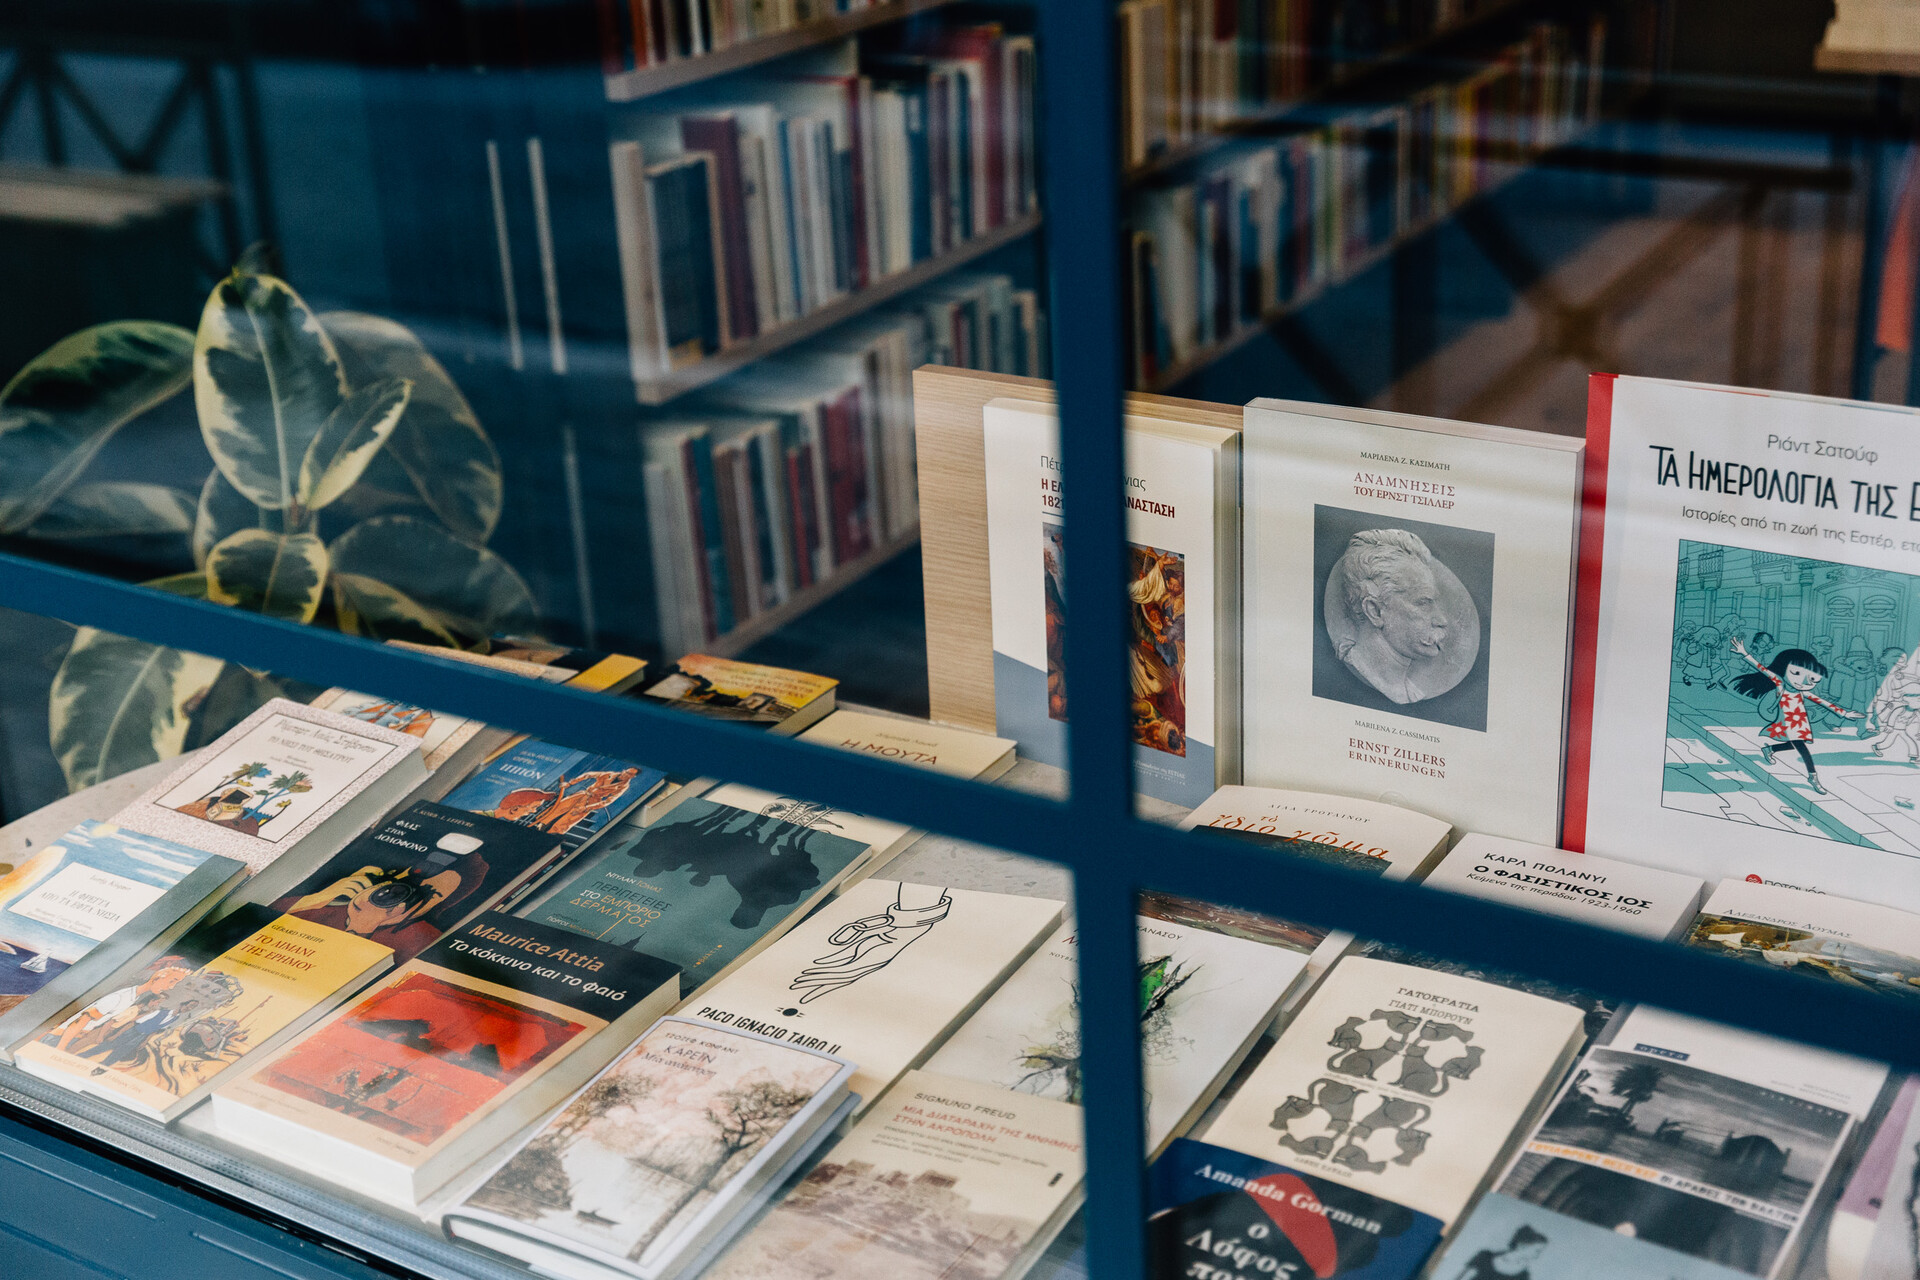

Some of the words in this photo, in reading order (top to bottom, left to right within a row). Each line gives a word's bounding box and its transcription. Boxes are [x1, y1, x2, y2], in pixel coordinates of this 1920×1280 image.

[1360, 451, 1400, 463] ΜΑΡΙΛΕΝΑ
[1409, 459, 1450, 471] ΚΑΣΙΜΑΤΗ
[1768, 434, 1810, 454] Ριάντ
[1815, 440, 1879, 466] Σατούφ
[1354, 472, 1456, 497] ΑΝΑΜΝΗΣΕΙΣ
[1649, 444, 1680, 487] ΤΑ
[1688, 450, 1839, 510] ΗΜΕΡΟΛΟΓΙΑ
[1851, 480, 1898, 519] ΤΗΣ
[1353, 486, 1375, 496] ΤΟΥ
[1376, 489, 1409, 503] ΕΡΝΣΤ
[1411, 494, 1455, 510] ΤΣΙΛΛΕΡ
[1682, 505, 1737, 528] Ιστορίες
[1740, 516, 1768, 530] από
[1772, 520, 1787, 532] τη
[1791, 522, 1818, 537] ζωή
[1822, 528, 1846, 543] της
[1354, 720, 1391, 733] MARILENA
[1399, 730, 1440, 743] CASSIMATIS
[840, 739, 861, 749] Η
[862, 743, 937, 765] ΜΟΥΤΑ
[1349, 738, 1390, 755] ERNST
[1393, 747, 1446, 767] ZILLERS
[1349, 751, 1446, 779] ERINNERUNGEN
[374, 833, 429, 853] ΔΟΛΟΦΟΝΟ
[384, 827, 407, 837] ΣΤΟΝ
[605, 871, 637, 884] ΝΤΥΛΑΝ
[1484, 853, 1526, 867] ΚΑΡΛ
[1532, 862, 1608, 884] ΠΟΛΑΝΥΙ
[591, 880, 673, 912] ΠΕΡΙΠΕΤΕΙΕΣ
[1466, 872, 1507, 887] Κείμενα
[1510, 883, 1528, 891] της
[1529, 887, 1577, 902] περιόδου
[1581, 897, 1642, 916] 1923-1960
[1474, 865, 1490, 873] Ο
[1493, 868, 1613, 901] ΦΑΣΙΣΤΙΚΟΣ
[1616, 895, 1654, 910] ΙΟΣ
[570, 897, 651, 930] ΔΕΡΜΑΤΟΣ
[579, 889, 601, 900] ΣΤΟ
[600, 894, 661, 919] ΕΜΠΟΡΙΟ
[1723, 909, 1799, 926] ΑΛΕΞΑΝΔΡΟΣ
[1802, 923, 1852, 938] ΔΟΥΜΑΣ
[240, 943, 267, 956] ΤΗΣ
[264, 951, 317, 971] ΕΡΗΜΟΥ
[255, 933, 273, 945] ΤΟ
[271, 940, 316, 957] ΛΙΜΑΝΙ
[468, 923, 551, 956] Maurice
[548, 948, 605, 973] Attia
[449, 939, 470, 952] Το
[468, 947, 532, 971] κόκκινο
[531, 966, 562, 981] και
[561, 974, 583, 988] το
[582, 981, 628, 1001] φαιό
[1388, 1000, 1419, 1012] ΓΙΑΤΙ
[1420, 1006, 1473, 1025] ΜΠΟΡΟΥΝ
[1397, 987, 1480, 1013] ΓΑΤΟΚΡΑΤΙΑ
[697, 1006, 735, 1023] PACO
[732, 1016, 788, 1040] IGNACIO
[913, 1092, 972, 1111] SIGMUND
[973, 1105, 1016, 1120] FREUD
[892, 1114, 927, 1128] ΣΤΗΝ
[927, 1123, 998, 1143] ΑΚΡΟΠΟΛΗ
[901, 1105, 924, 1117] ΜΙΑ
[926, 1111, 996, 1132] ΔΙΑΤΑΡΑΧΗ
[999, 1126, 1023, 1139] ΤΗΣ
[1024, 1133, 1081, 1153] ΜΝΗΜΗΣ
[1194, 1164, 1286, 1202] Amanda
[1290, 1192, 1383, 1235] Gorman
